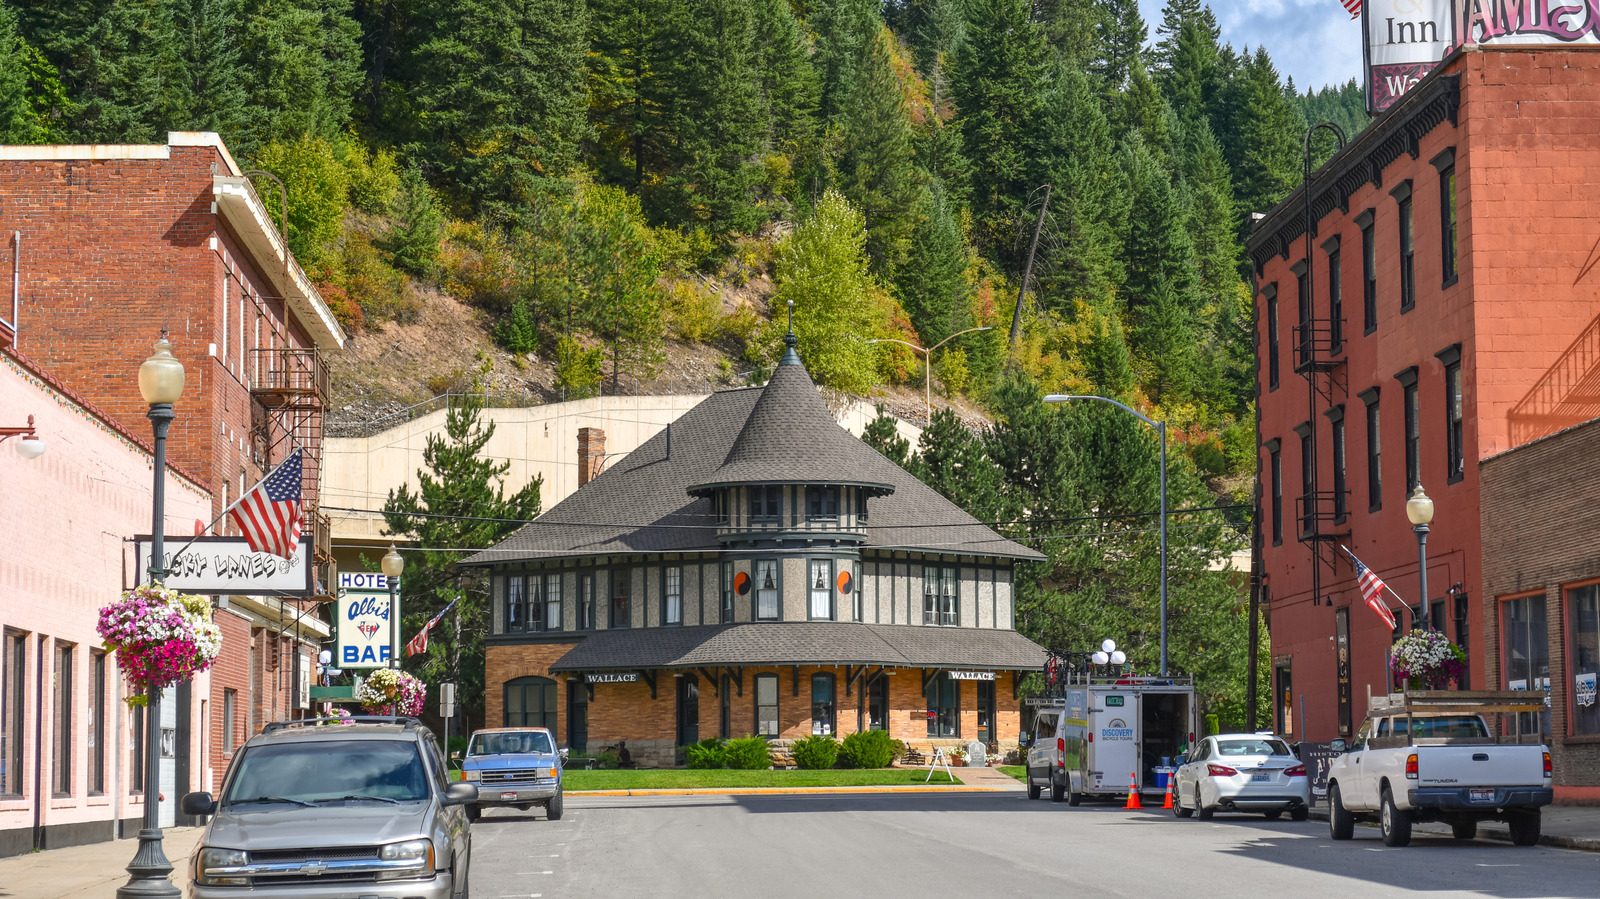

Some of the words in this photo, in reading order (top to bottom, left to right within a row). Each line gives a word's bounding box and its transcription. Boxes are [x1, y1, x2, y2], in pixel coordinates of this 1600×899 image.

[1385, 17, 1439, 45] Inn
[147, 552, 207, 579] UCKY
[214, 553, 276, 579] LANES
[342, 574, 386, 588] HOTE
[359, 624, 378, 633] GEM
[588, 674, 637, 683] WALLACE
[951, 672, 994, 680] WALLACE
[1102, 729, 1133, 737] DISCOVERY
